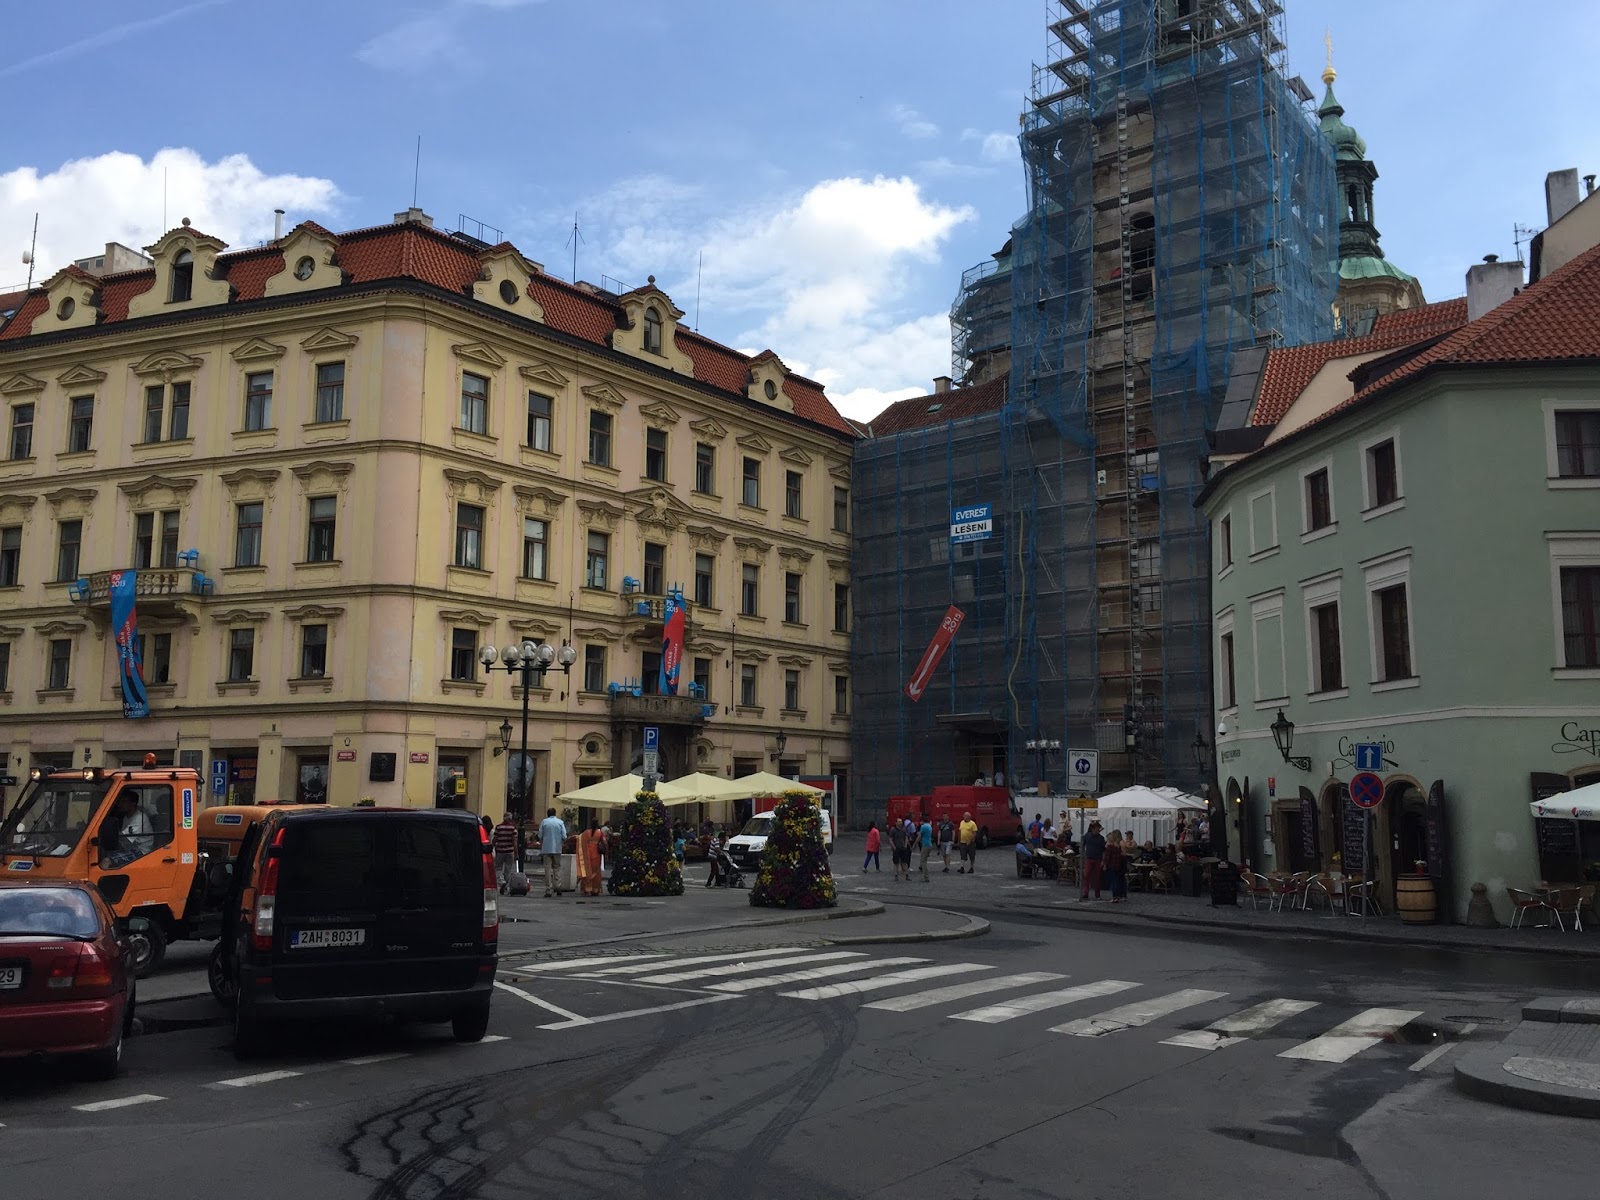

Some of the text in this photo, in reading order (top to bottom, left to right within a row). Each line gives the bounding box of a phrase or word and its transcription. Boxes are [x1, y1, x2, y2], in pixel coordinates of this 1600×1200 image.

[955, 507, 988, 521] EVEREST
[955, 521, 987, 534] LEŠENÍ
[111, 580, 126, 588] 2015
[947, 613, 962, 633] 2015
[646, 730, 656, 744] P
[215, 778, 224, 790] P
[301, 930, 360, 944] 2AH 8031
